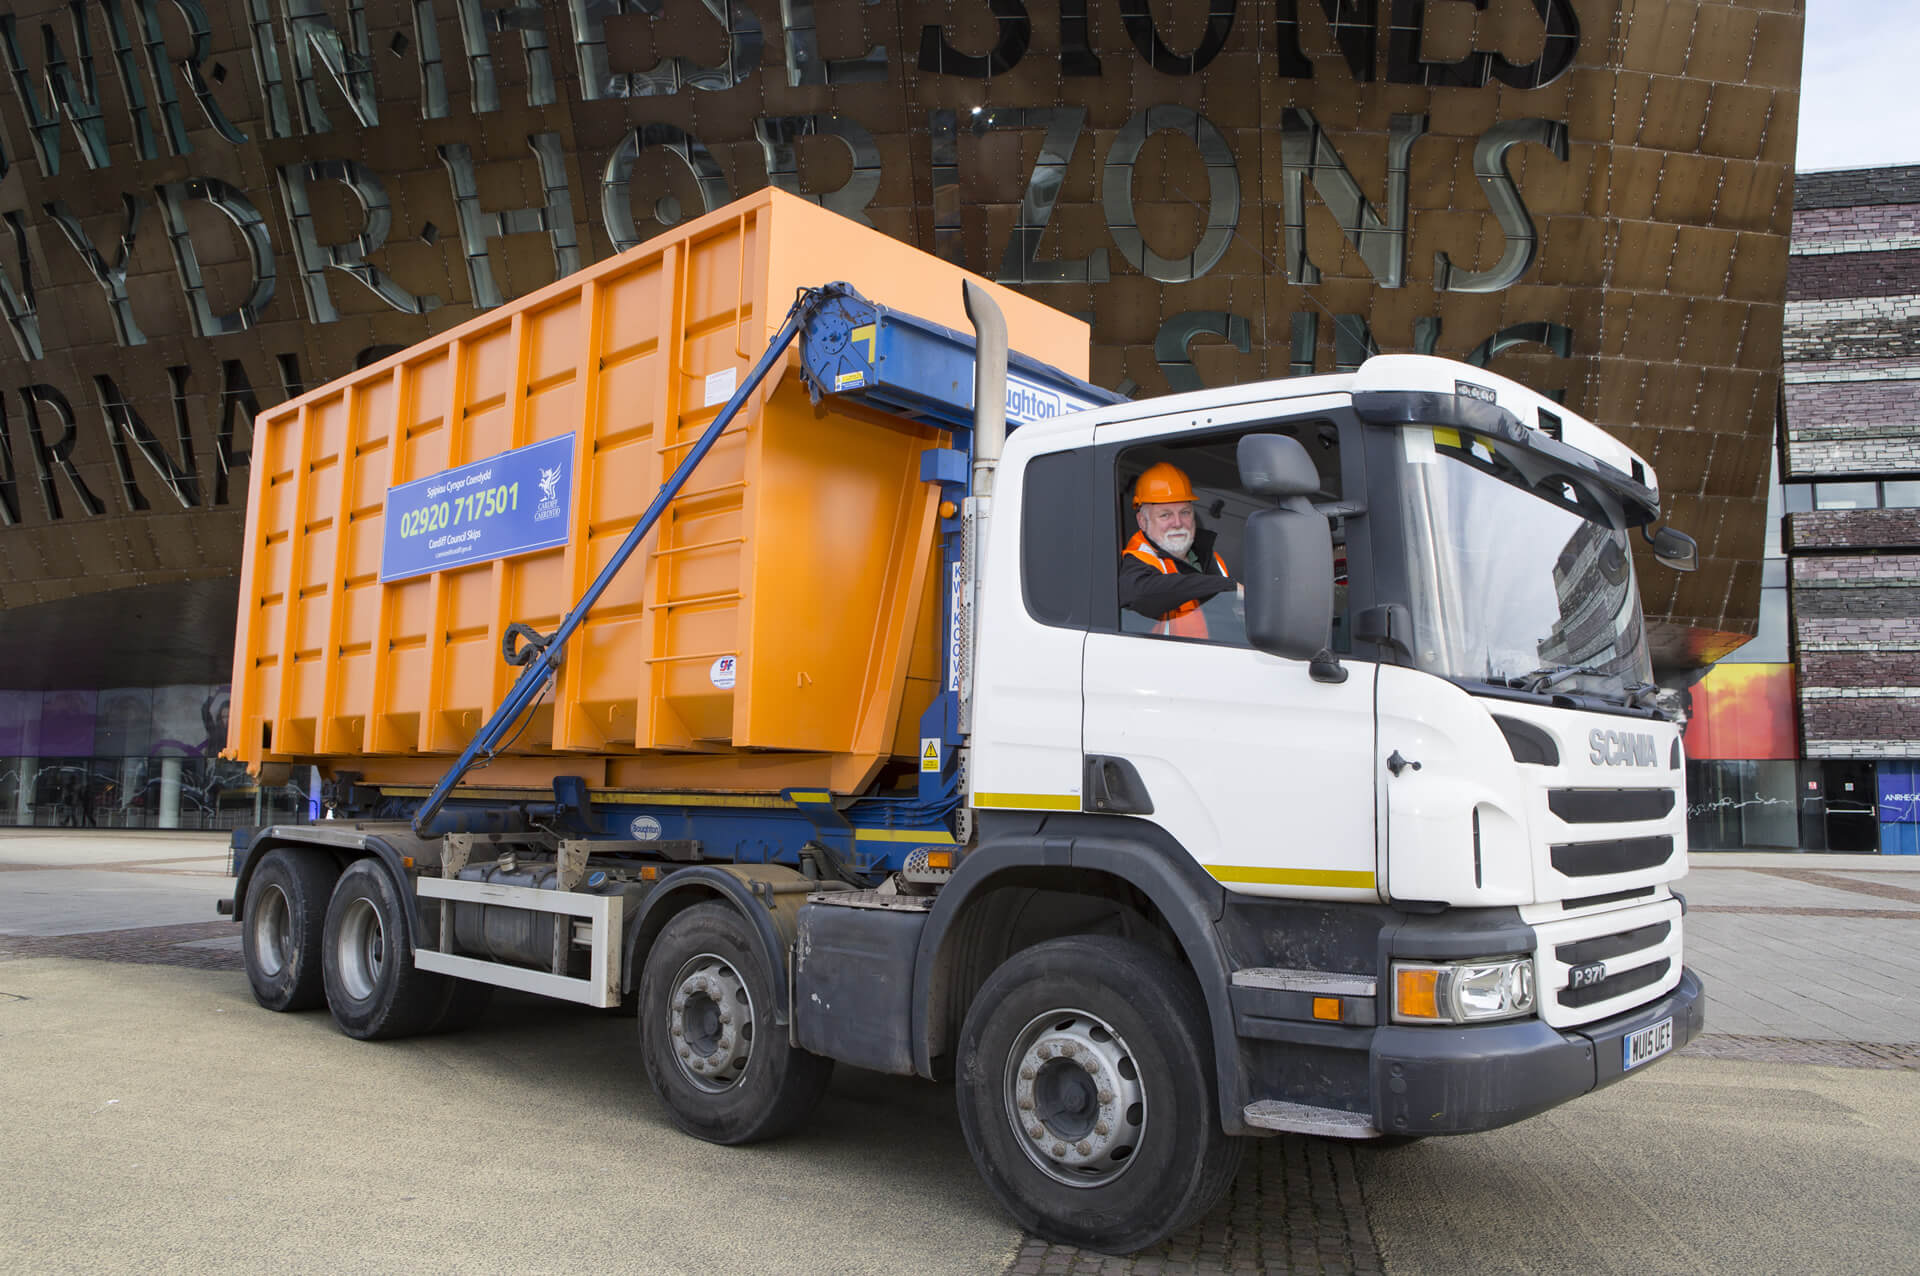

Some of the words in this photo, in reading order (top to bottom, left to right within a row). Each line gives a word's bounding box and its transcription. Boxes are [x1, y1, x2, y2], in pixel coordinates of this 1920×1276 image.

[400, 501, 449, 538] 02920
[453, 481, 519, 526] 717501
[447, 531, 466, 545] Council
[467, 529, 481, 541] Skips
[1589, 727, 1658, 768] SCANIA
